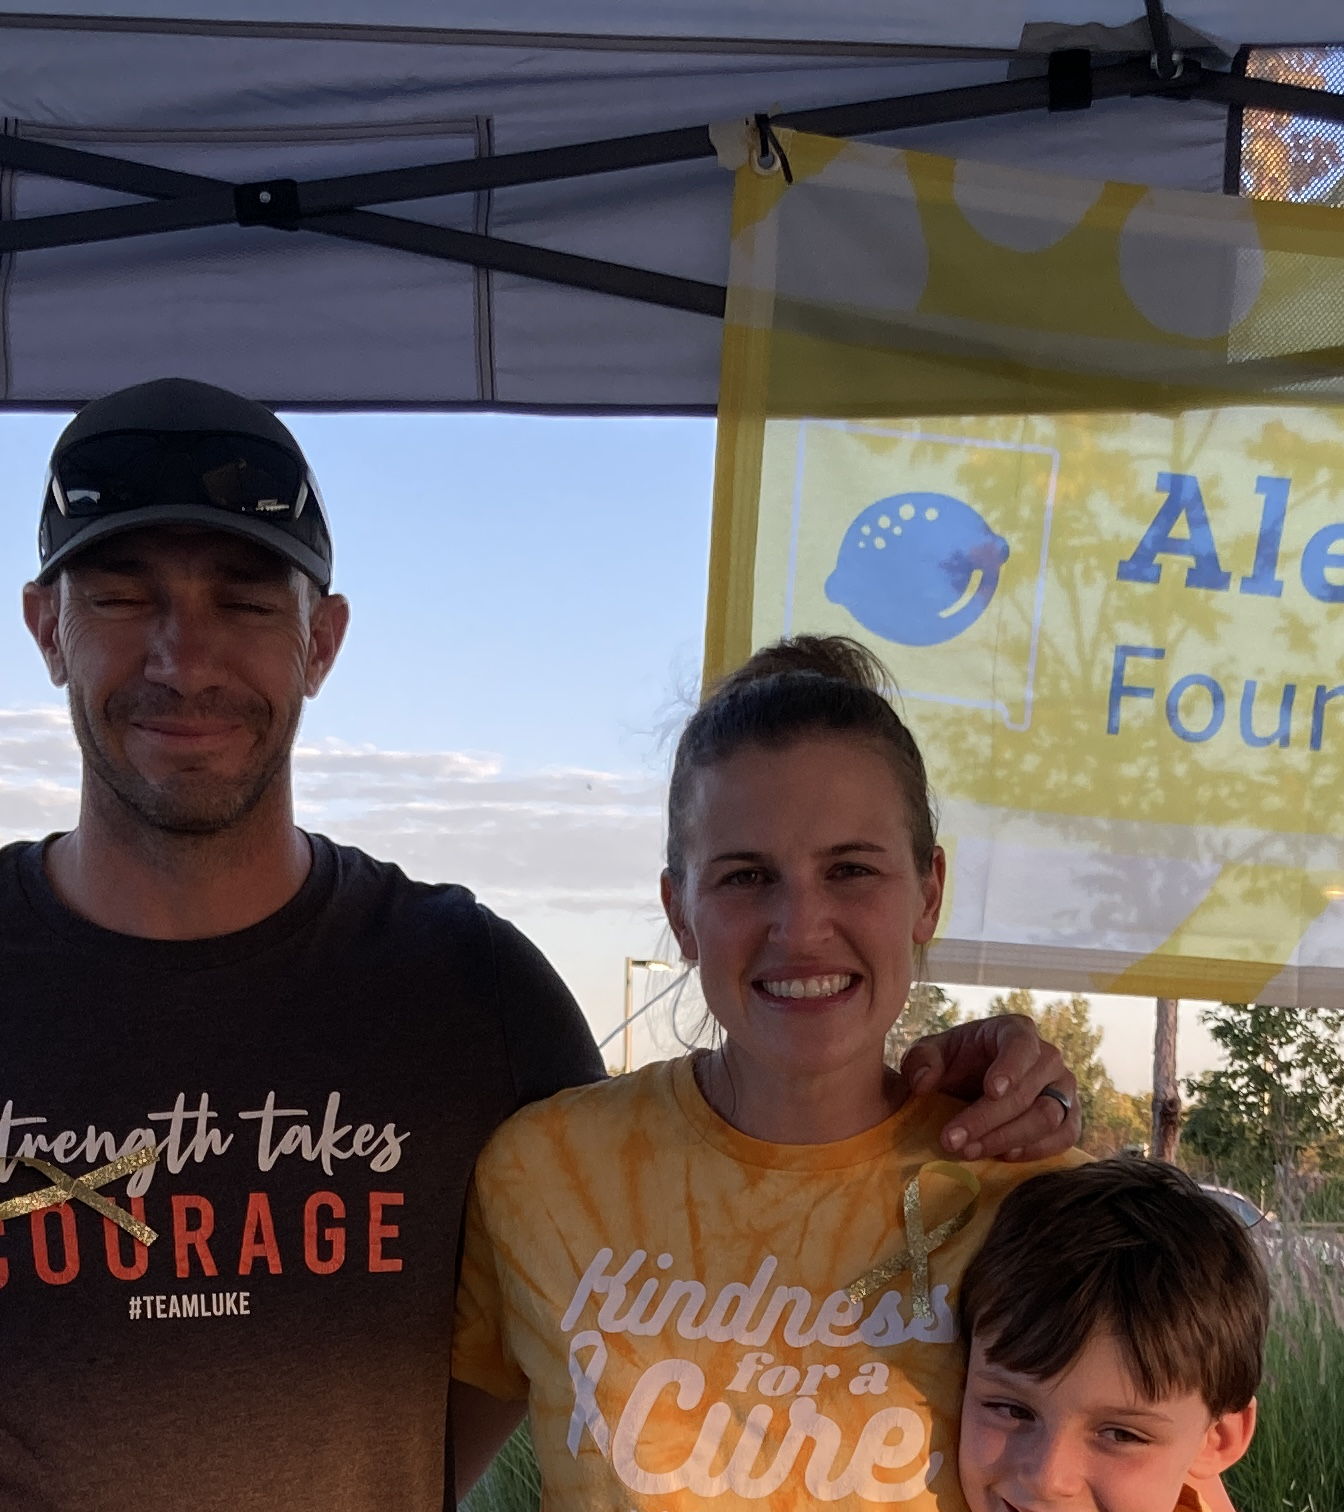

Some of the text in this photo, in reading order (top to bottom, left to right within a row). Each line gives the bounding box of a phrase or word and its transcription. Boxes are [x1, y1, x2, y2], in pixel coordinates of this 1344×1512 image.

[238, 1090, 411, 1178] takes
[128, 1291, 252, 1321] #TEAMLUKE
[560, 1247, 956, 1349] Kindness
[724, 1352, 890, 1398] for a
[610, 1358, 942, 1504] Cure
